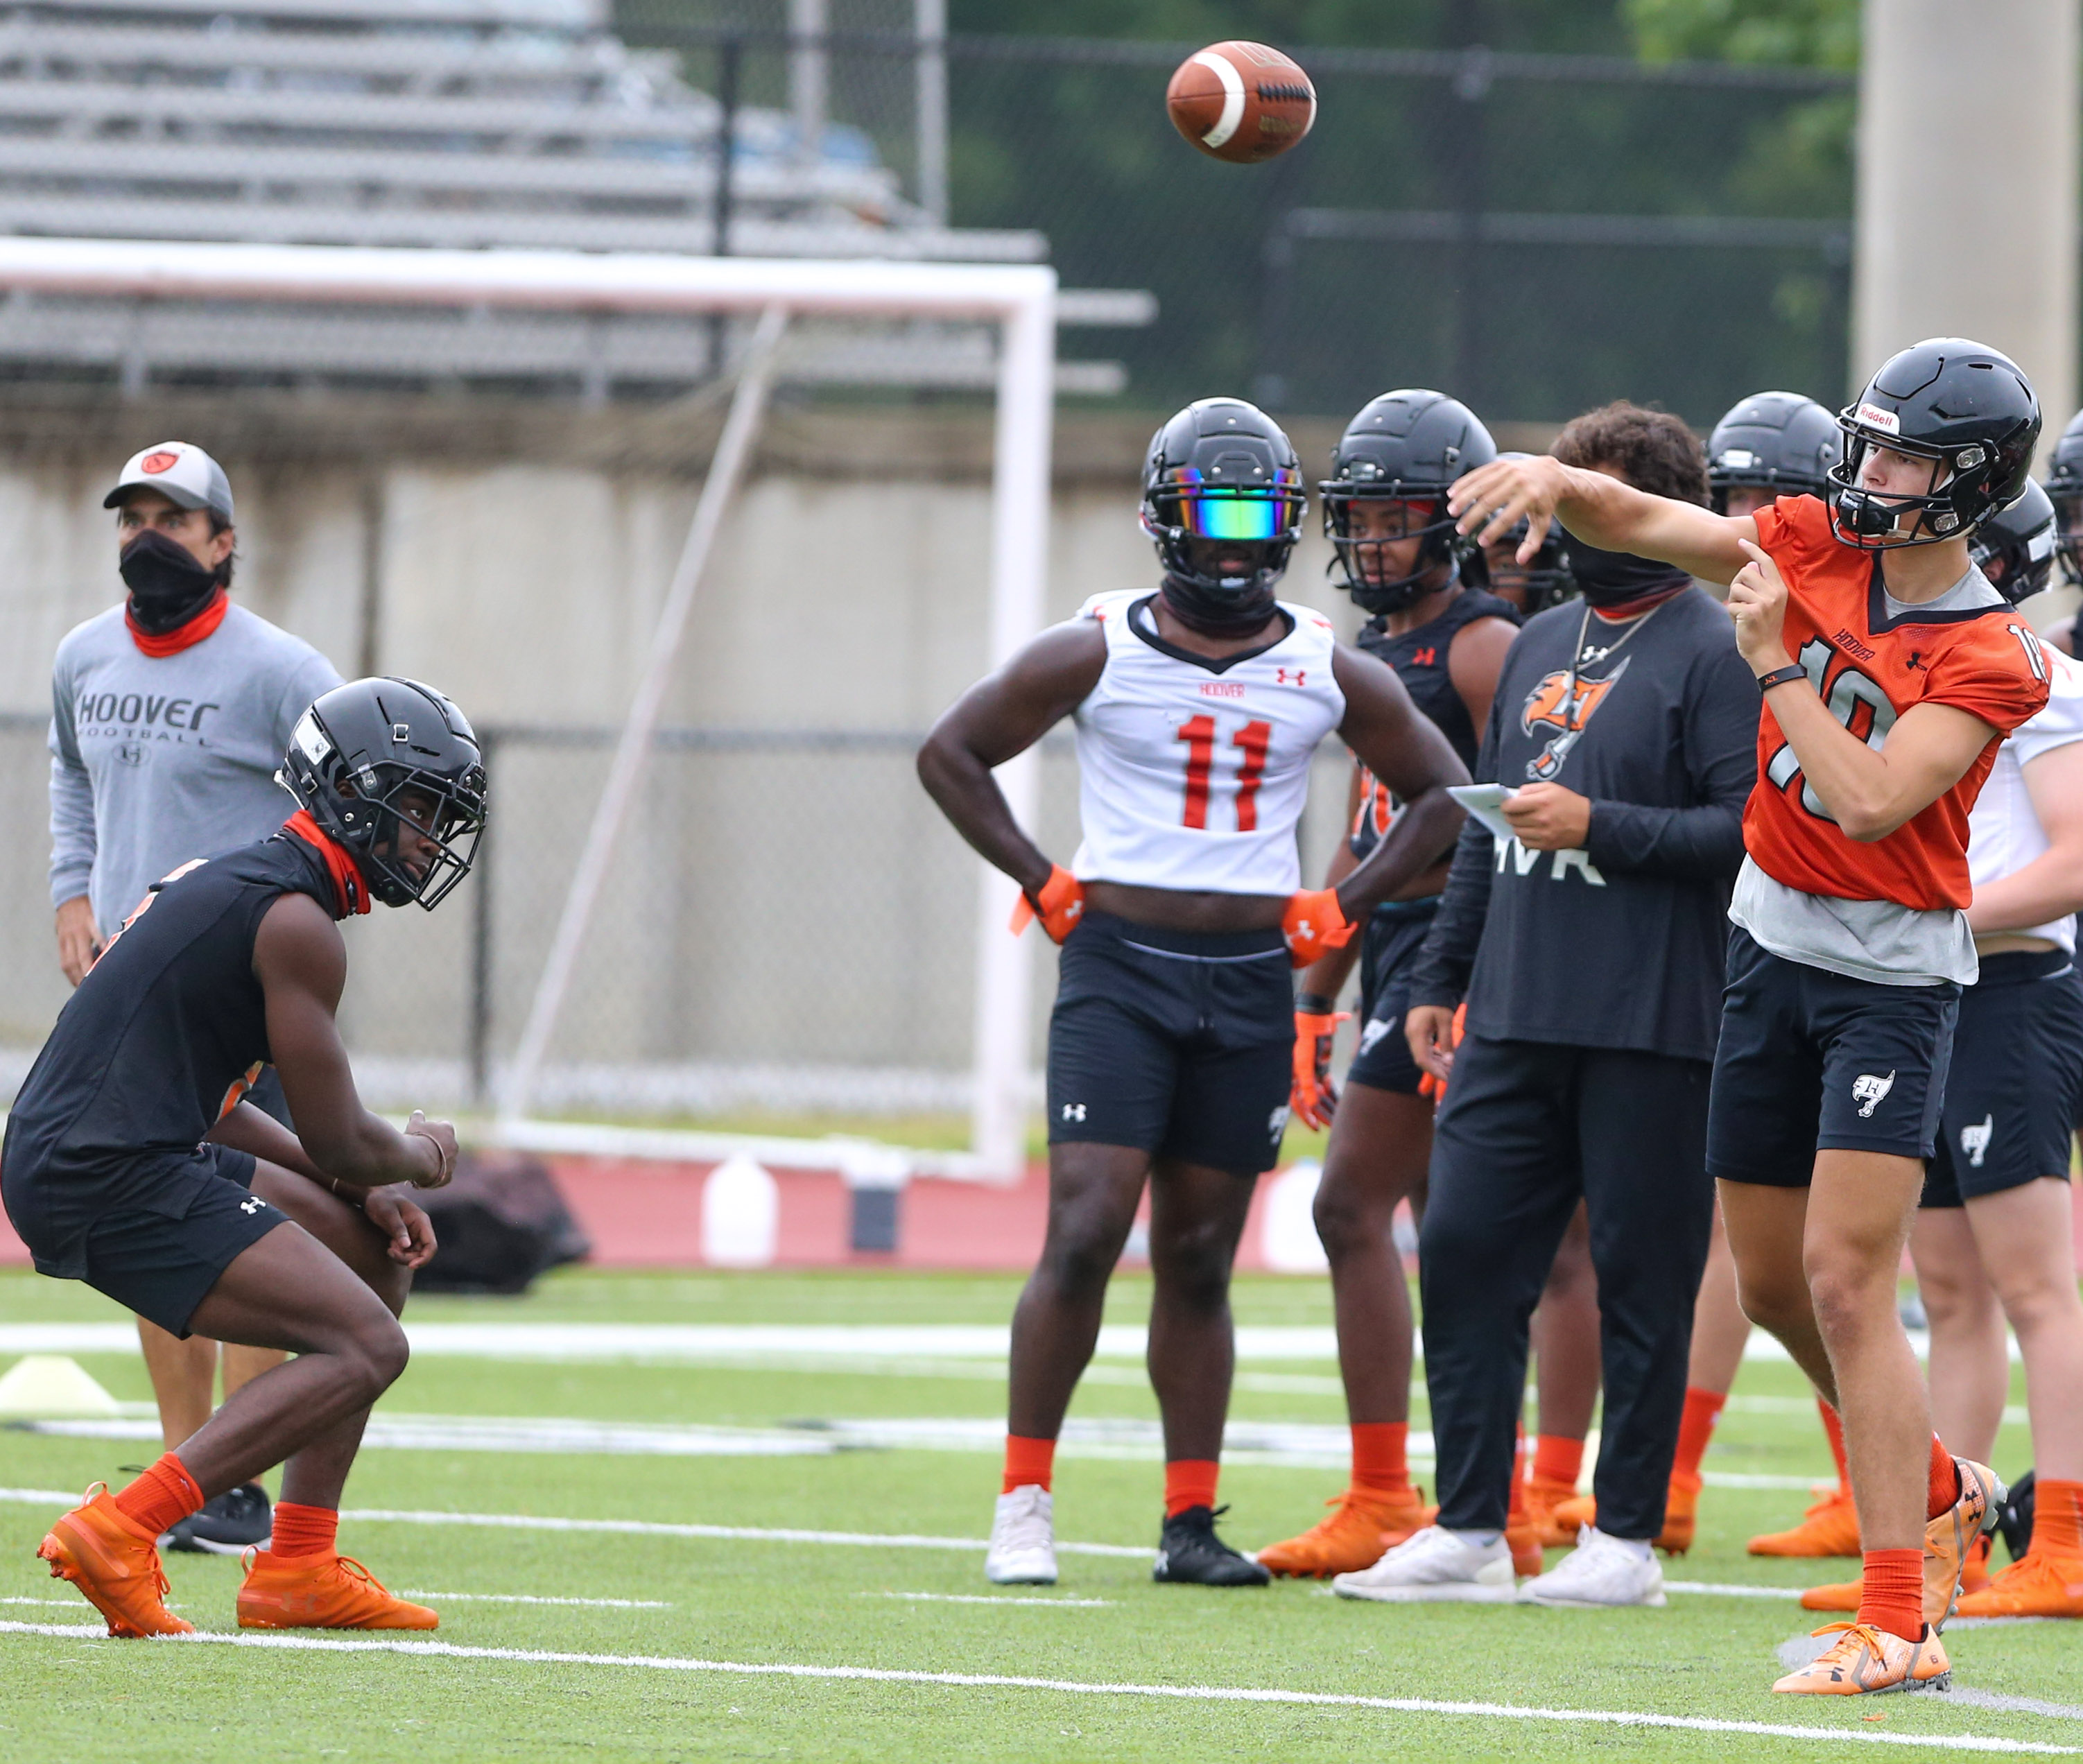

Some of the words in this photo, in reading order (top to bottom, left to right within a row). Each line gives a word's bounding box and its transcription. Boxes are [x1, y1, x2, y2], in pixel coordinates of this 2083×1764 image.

[1860, 406, 1893, 426] Riddell
[1833, 628, 1875, 662] HOOVER
[1200, 682, 1245, 698] HOOVER
[78, 727, 215, 747] OOTBALL
[1175, 714, 1272, 832] 11
